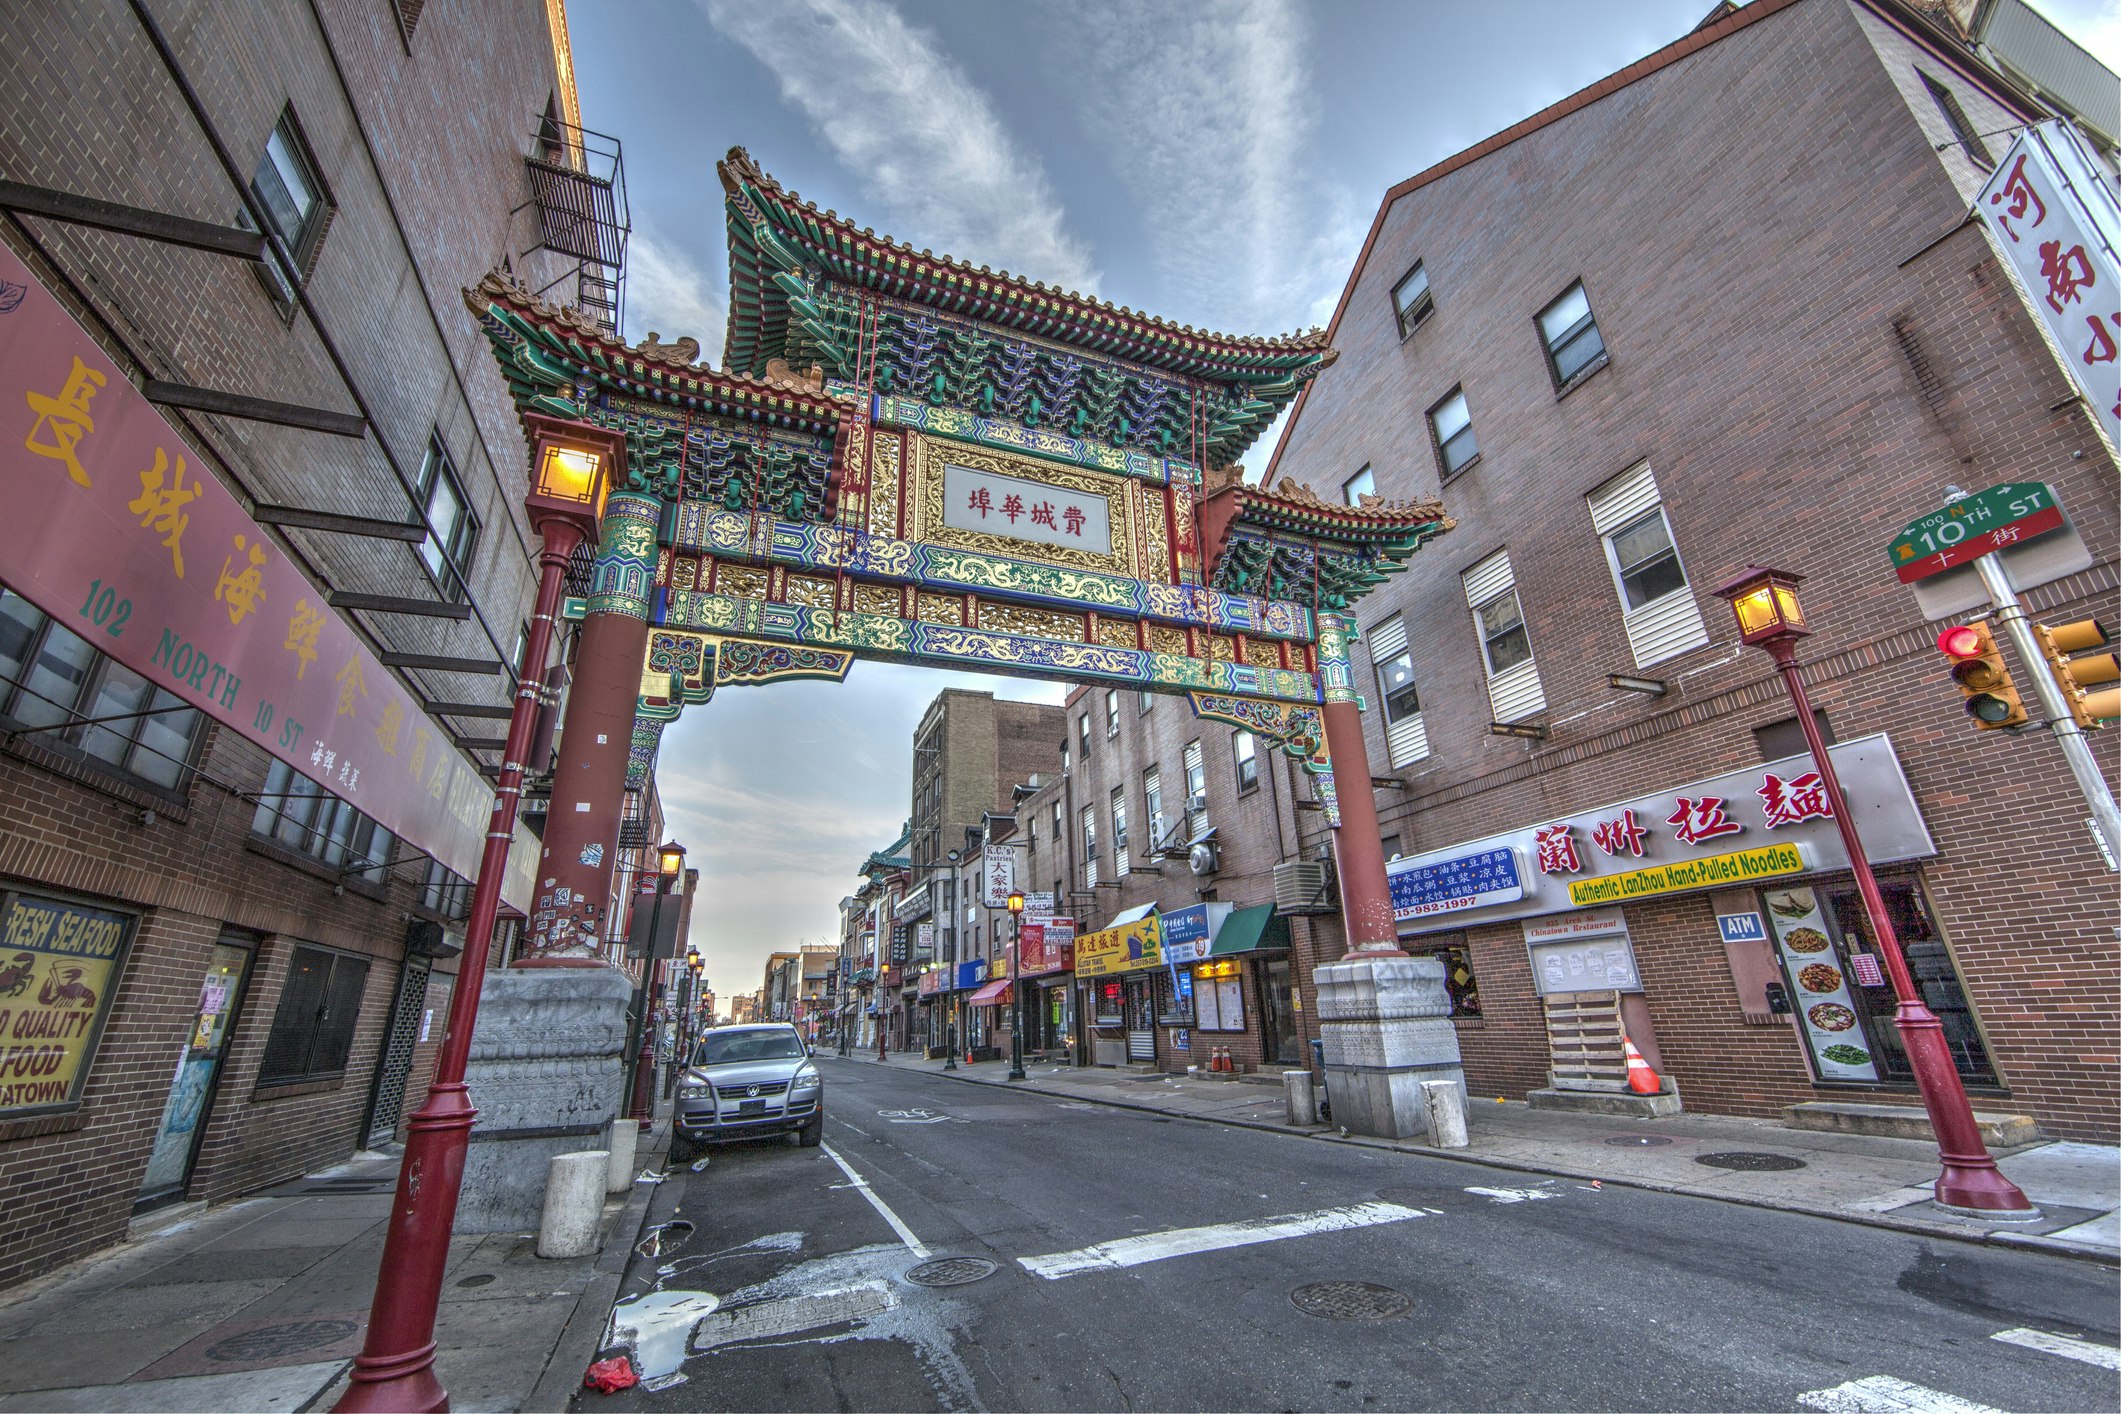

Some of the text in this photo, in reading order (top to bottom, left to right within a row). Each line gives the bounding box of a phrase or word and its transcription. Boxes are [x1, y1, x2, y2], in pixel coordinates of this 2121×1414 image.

[1920, 515, 1944, 530] 100
[1948, 504, 1966, 518] N
[1920, 492, 2041, 552] 10TH ST
[79, 578, 305, 753] 102 NORTH 10 ST
[1573, 848, 1798, 903] Authentic LanZhou Hand-Pulled Noodles
[50, 911, 122, 956] SEAFOOD
[1531, 920, 1616, 938] Chinatown Restaurant
[1727, 916, 1755, 935] ATM
[12, 1010, 93, 1041] QUALITY
[0, 1044, 65, 1079] FOOD
[0, 1080, 70, 1107] ATOWN
